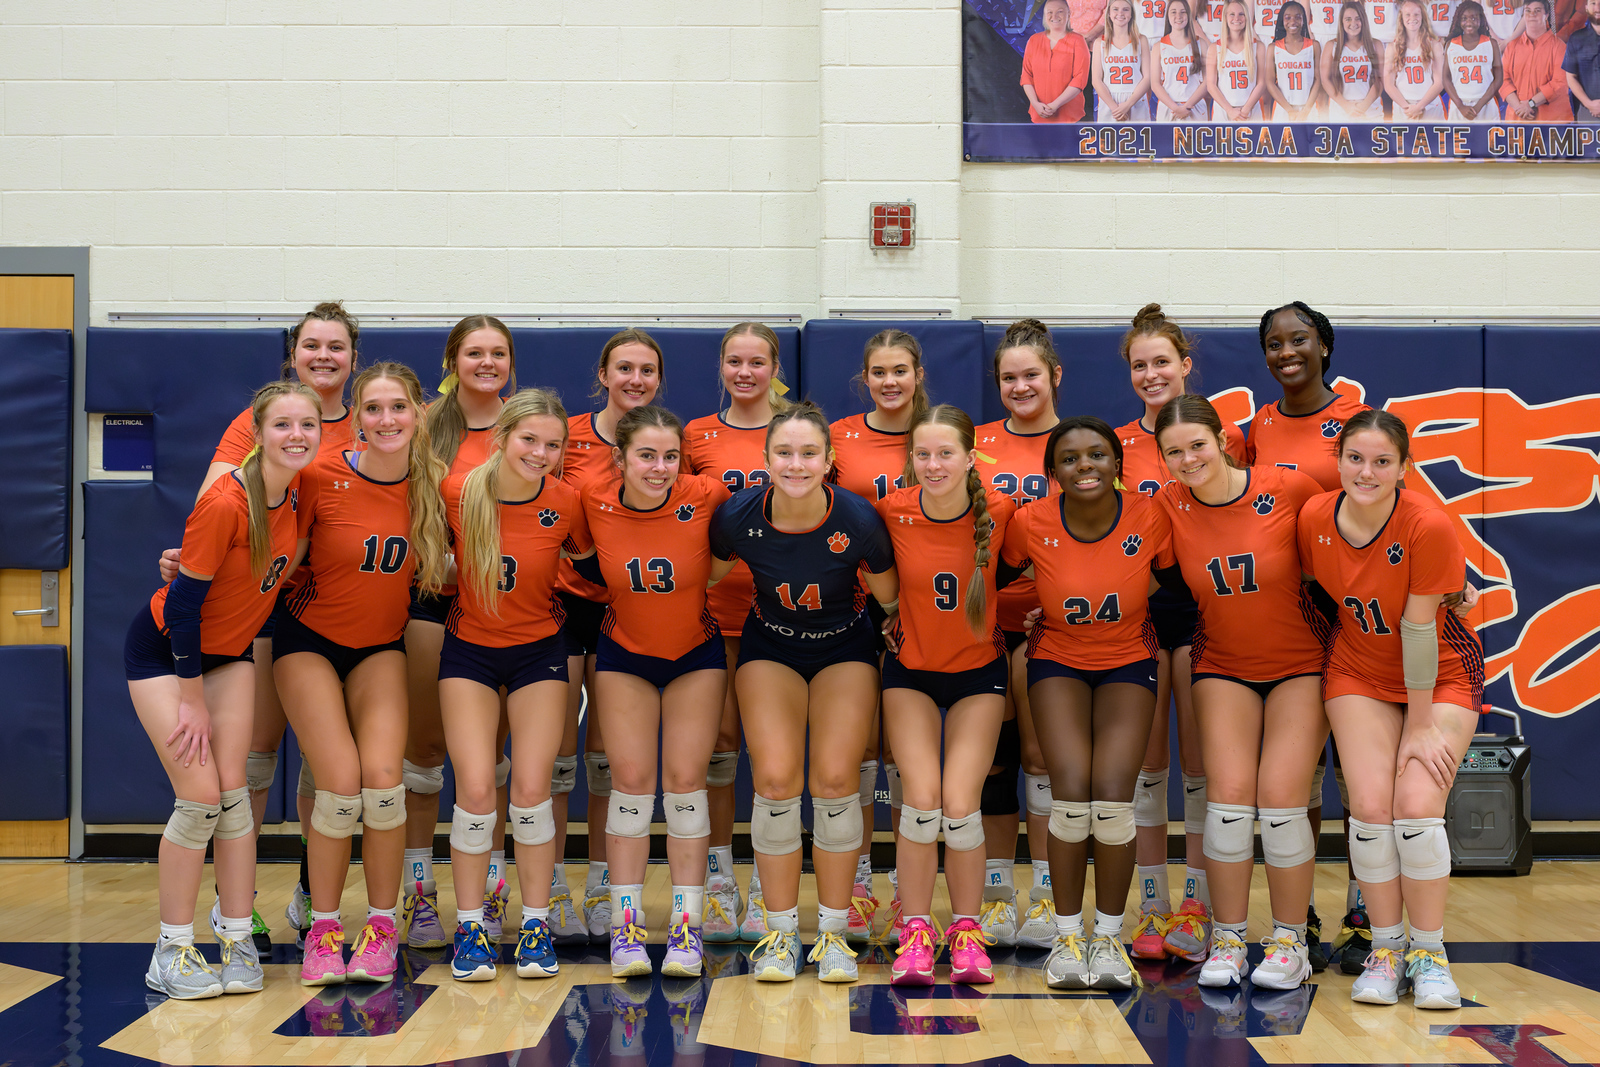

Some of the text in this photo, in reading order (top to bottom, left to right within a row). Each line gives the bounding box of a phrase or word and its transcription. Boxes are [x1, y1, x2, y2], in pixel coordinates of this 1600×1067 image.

[1142, 0, 1166, 18] 33
[1206, 4, 1224, 22] 14
[1323, 7, 1334, 24] 3
[1374, 6, 1385, 24] 5
[1431, 4, 1449, 21] 12
[1104, 56, 1138, 64] COUGARS
[1163, 56, 1194, 65] COUGAR
[1278, 61, 1311, 69] COUGARS
[1453, 55, 1488, 64] COUGARS
[1110, 66, 1133, 84] 22
[1176, 66, 1188, 84] 4
[1229, 70, 1248, 89] 15
[1288, 72, 1302, 90] 11
[1342, 65, 1368, 83] 24
[1405, 66, 1424, 84] 10
[1458, 66, 1482, 84] 34
[1079, 127, 1156, 155] 2021
[1173, 127, 1298, 155] NCHSAA
[1314, 127, 1354, 155] 3A
[1371, 127, 1471, 156] STATE
[991, 472, 1049, 507] 29
[359, 535, 408, 574] 10
[625, 557, 676, 594] 13
[1205, 552, 1260, 596] 17
[775, 582, 823, 611] 14
[932, 572, 959, 611] 9
[1063, 592, 1122, 625] 24
[1343, 595, 1392, 635] 31
